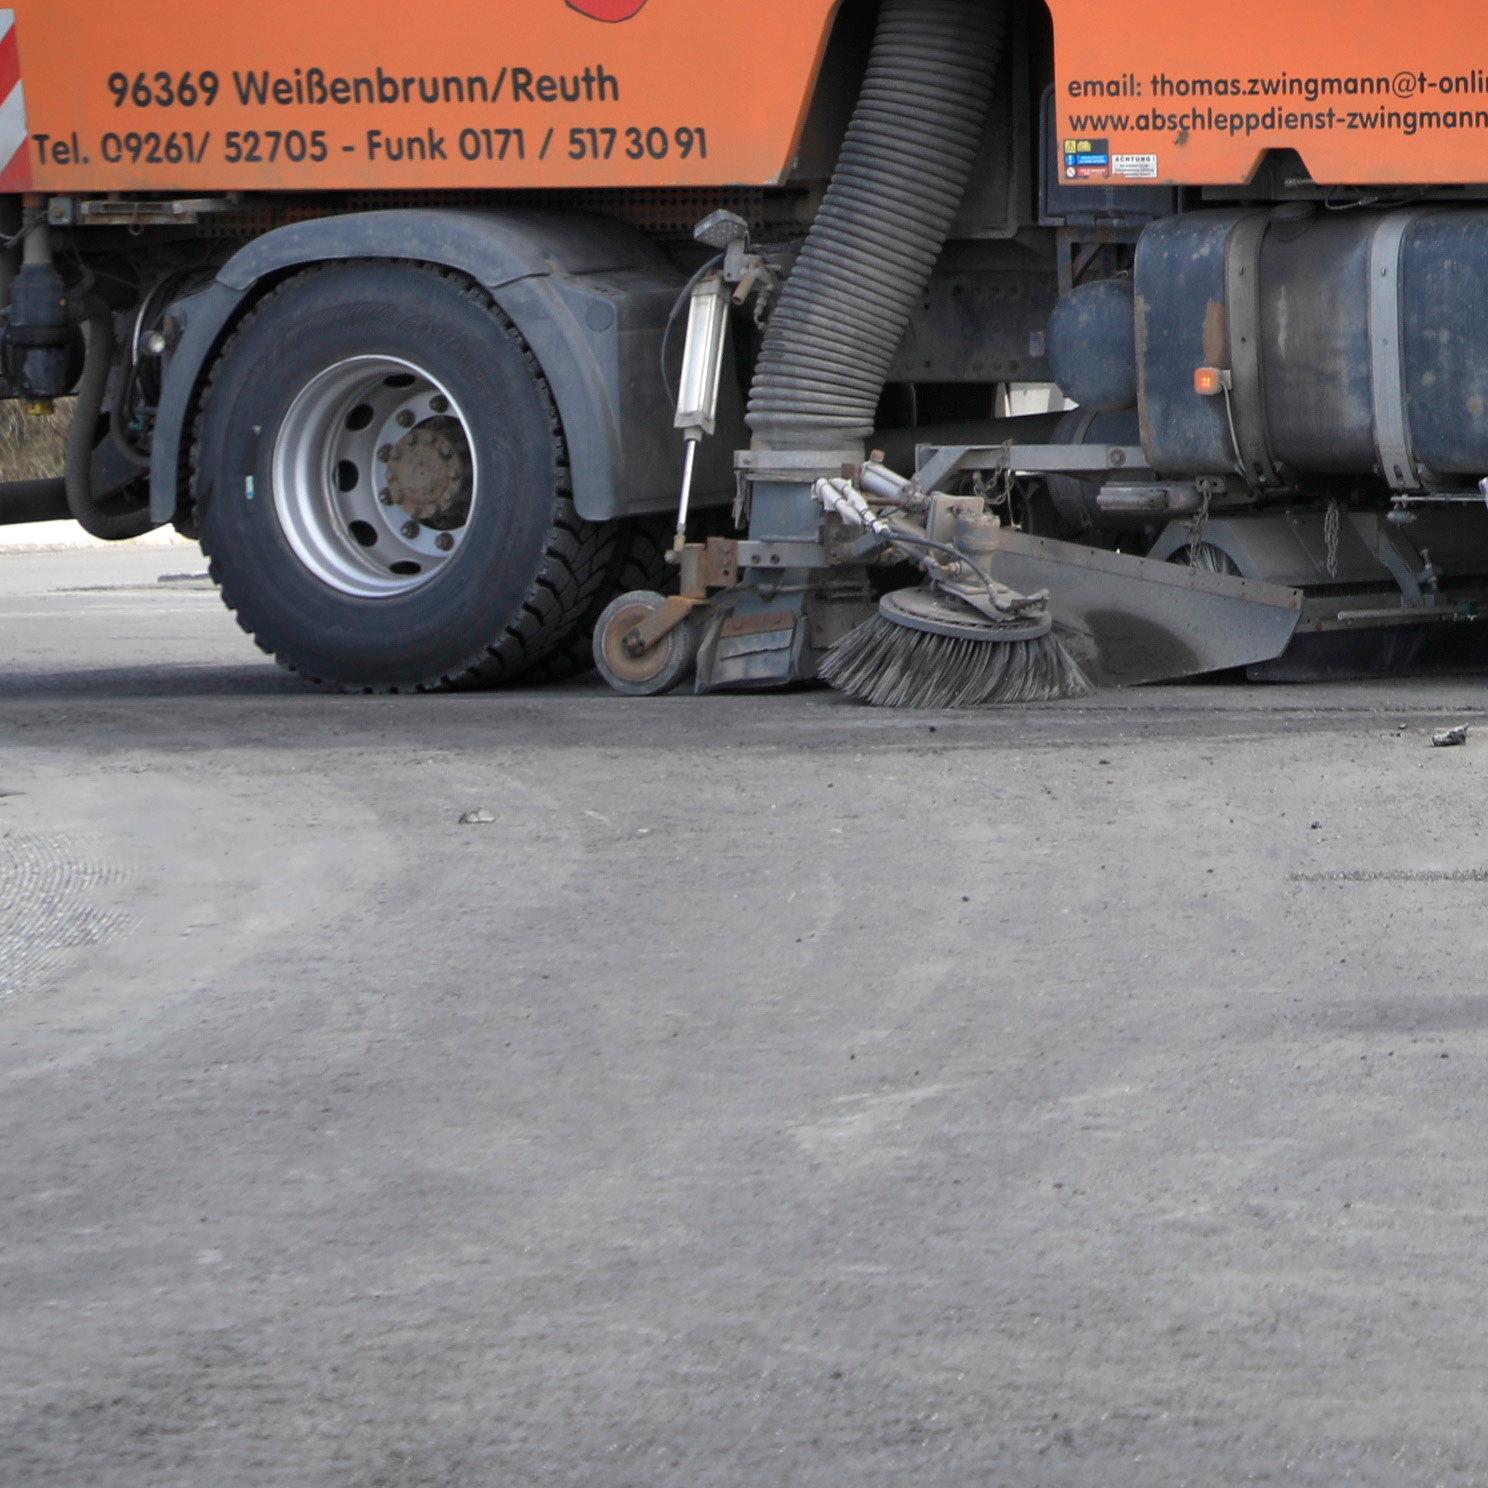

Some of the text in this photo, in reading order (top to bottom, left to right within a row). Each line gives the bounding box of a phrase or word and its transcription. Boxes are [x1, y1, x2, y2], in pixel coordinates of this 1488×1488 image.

[107, 63, 620, 108] 96369 Weißenbrunn/Reuth
[1067, 72, 1142, 98] email:
[32, 131, 89, 165] Tel.
[224, 129, 330, 164] 52705
[366, 126, 448, 162] Funk
[458, 127, 526, 162] 0171
[538, 126, 554, 161] /
